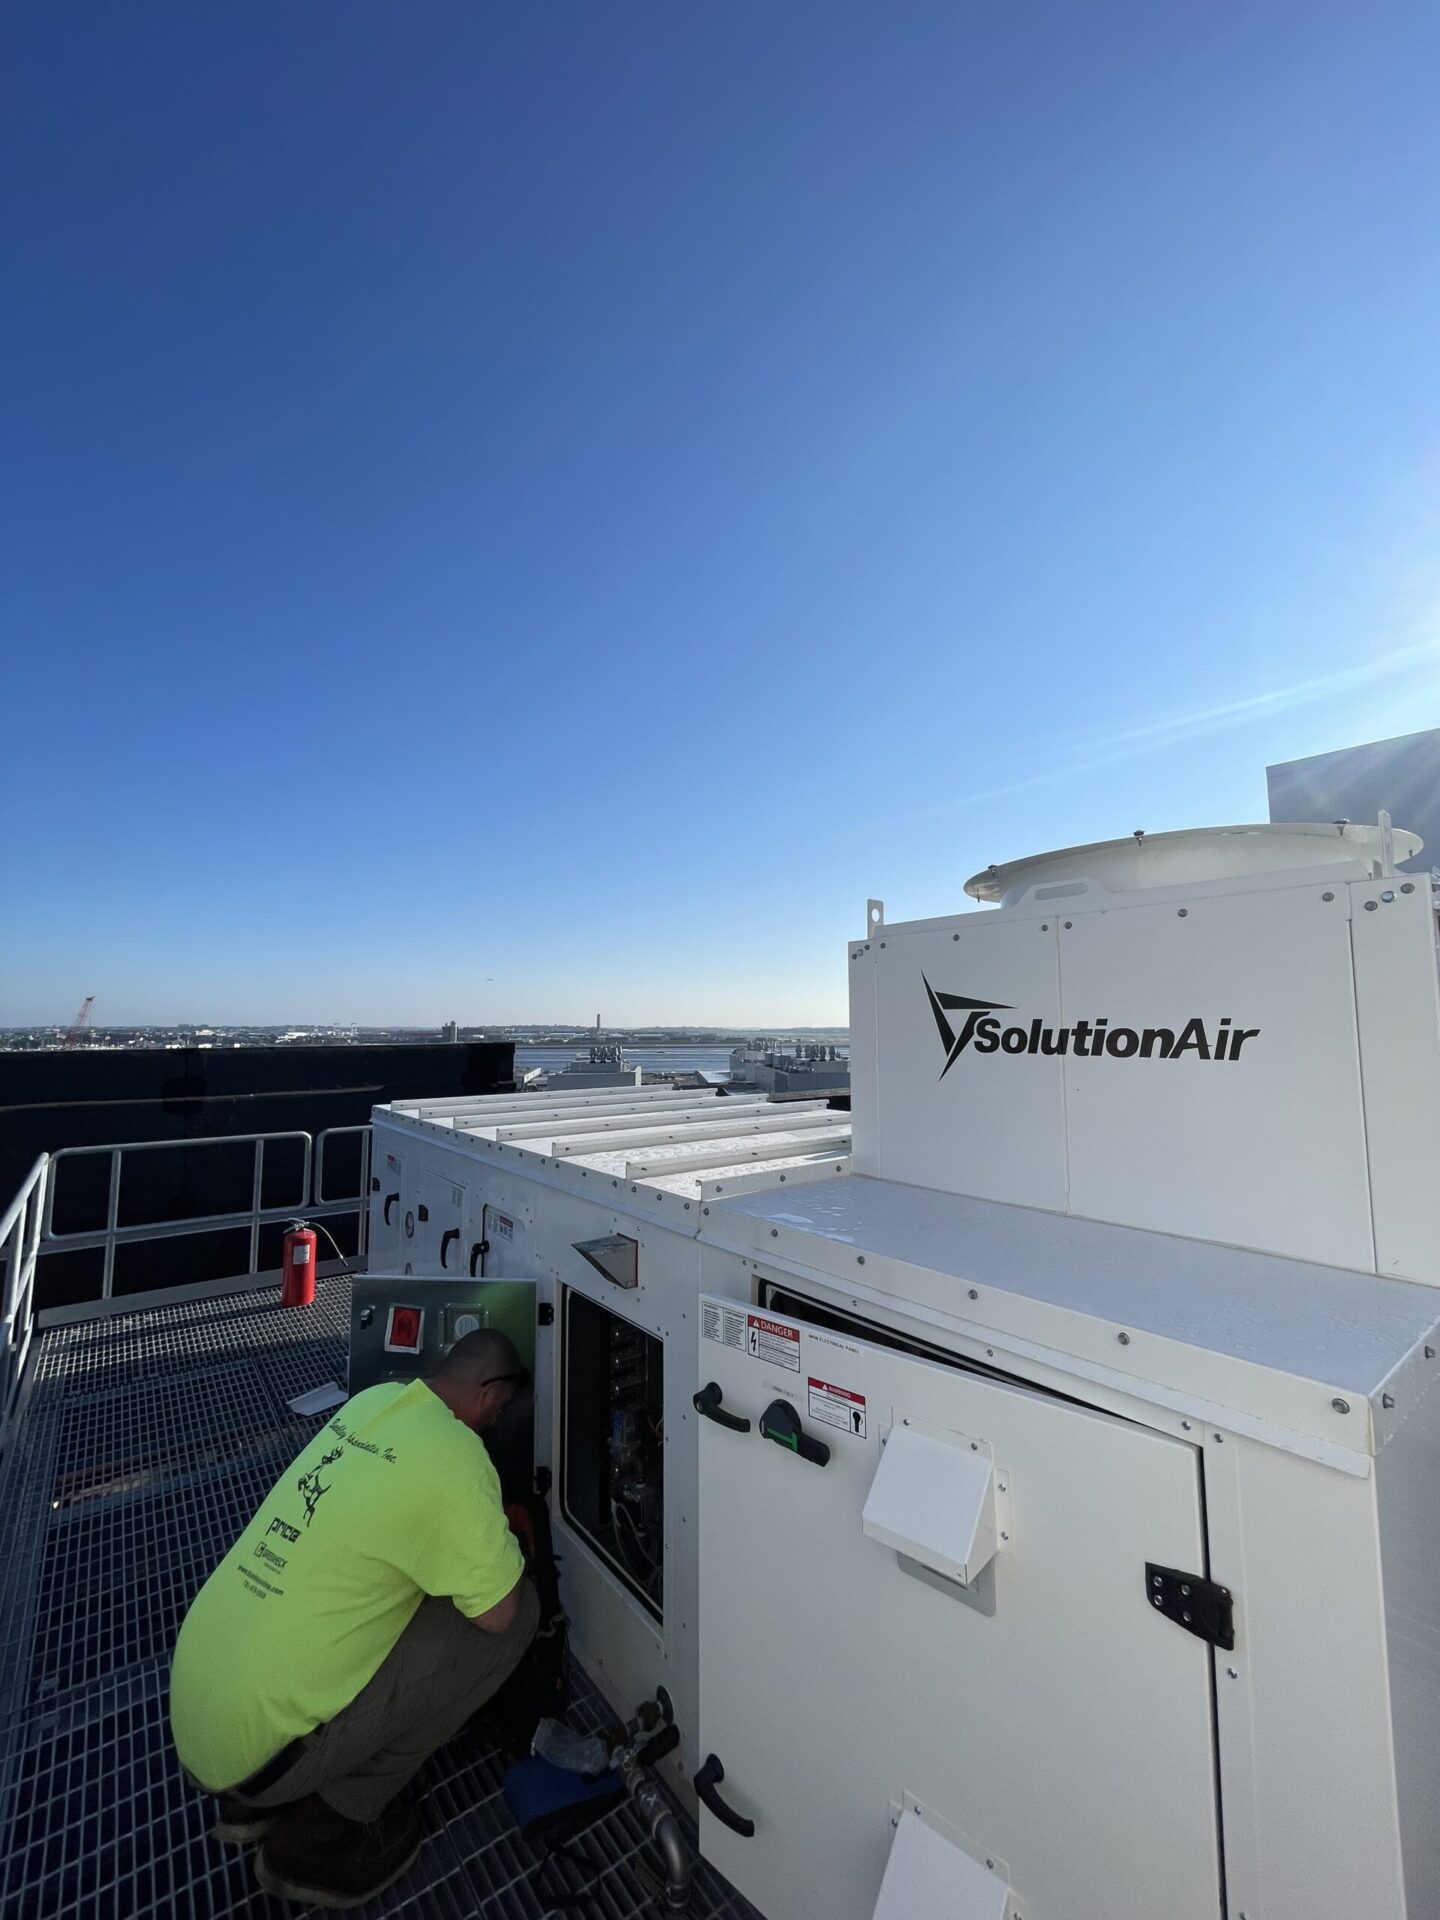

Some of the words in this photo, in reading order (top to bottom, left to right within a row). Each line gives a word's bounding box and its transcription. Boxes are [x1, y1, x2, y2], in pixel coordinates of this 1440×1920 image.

[973, 1017, 1261, 1061] SolutionAir
[760, 1320, 793, 1338] DANGER
[265, 1516, 302, 1544] price
